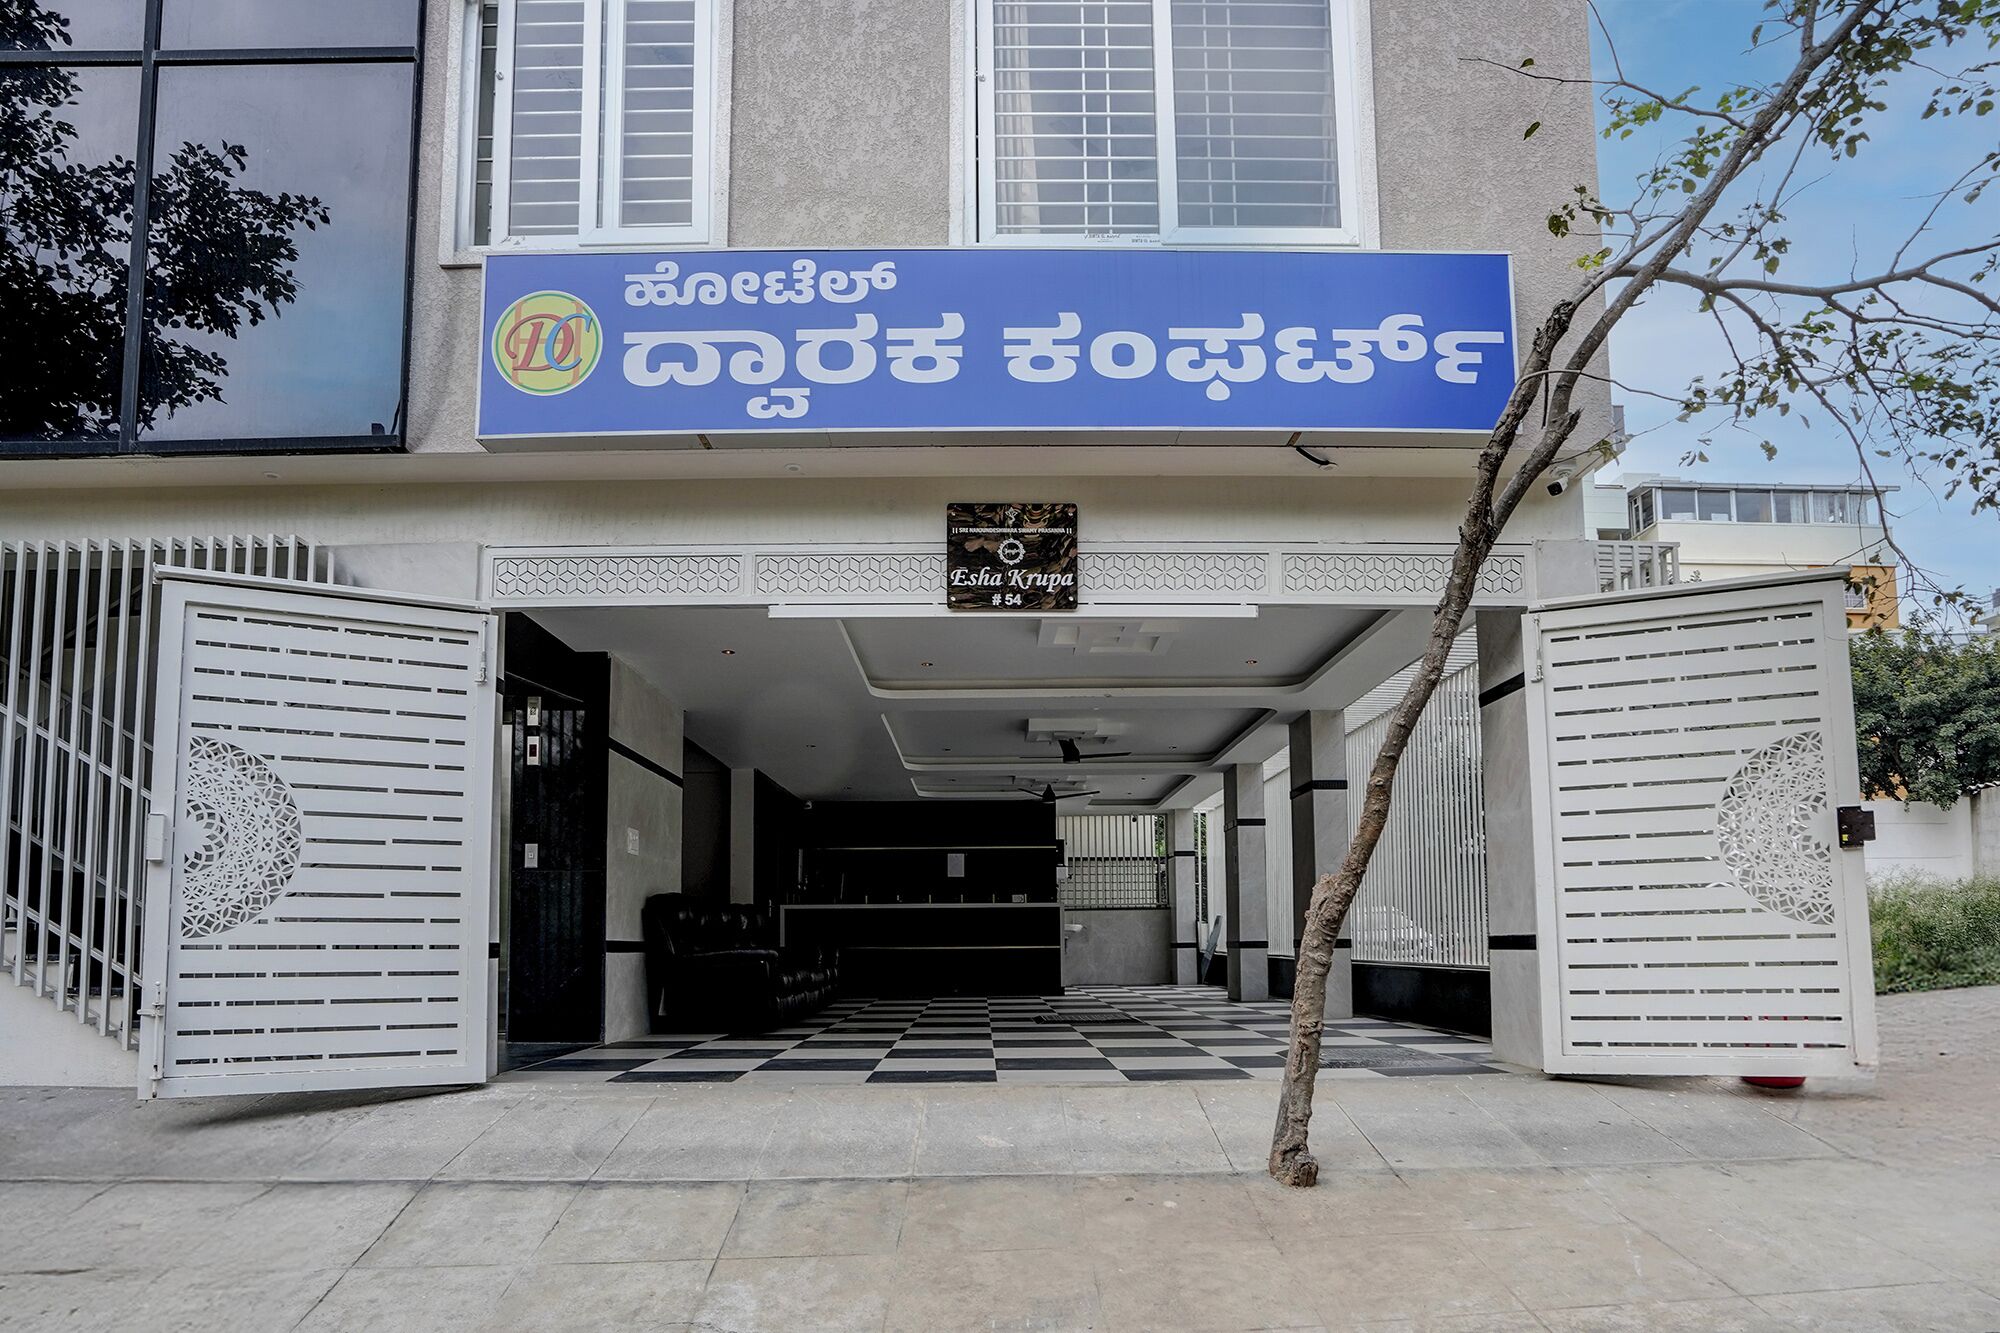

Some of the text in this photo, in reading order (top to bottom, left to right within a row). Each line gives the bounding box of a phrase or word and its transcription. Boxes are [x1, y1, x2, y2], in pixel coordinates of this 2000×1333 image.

[624, 258, 897, 307] ಹೋಟೆಲ್
[622, 312, 1505, 420] ದ್ವಾರಕ ಕಂಫರ್ಟ್
[950, 566, 1075, 592] Esha Krupa
[1005, 593, 1022, 606] 54
